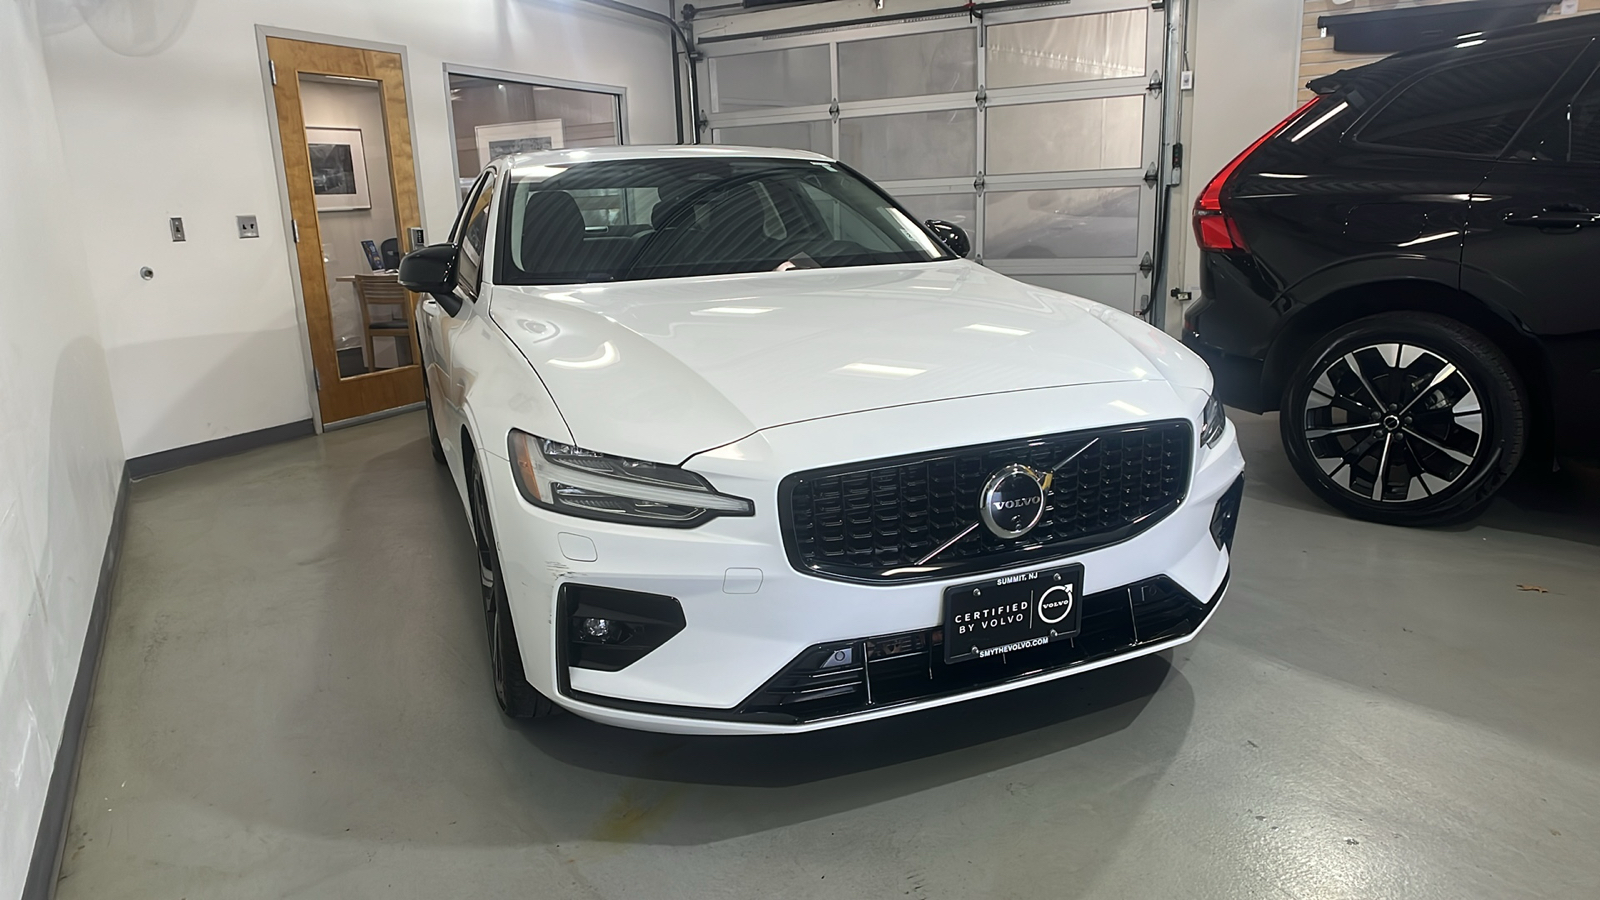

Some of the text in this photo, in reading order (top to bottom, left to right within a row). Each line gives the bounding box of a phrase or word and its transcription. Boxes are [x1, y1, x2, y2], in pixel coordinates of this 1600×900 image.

[993, 496, 1040, 510] VOLVO
[1028, 571, 1038, 580] NJ
[954, 601, 1028, 623] CERTIFIED
[1042, 599, 1069, 609] VOLVO
[959, 613, 1024, 634] BY VOLVO
[979, 636, 1049, 658] SMYTHEVOLVO.COM
